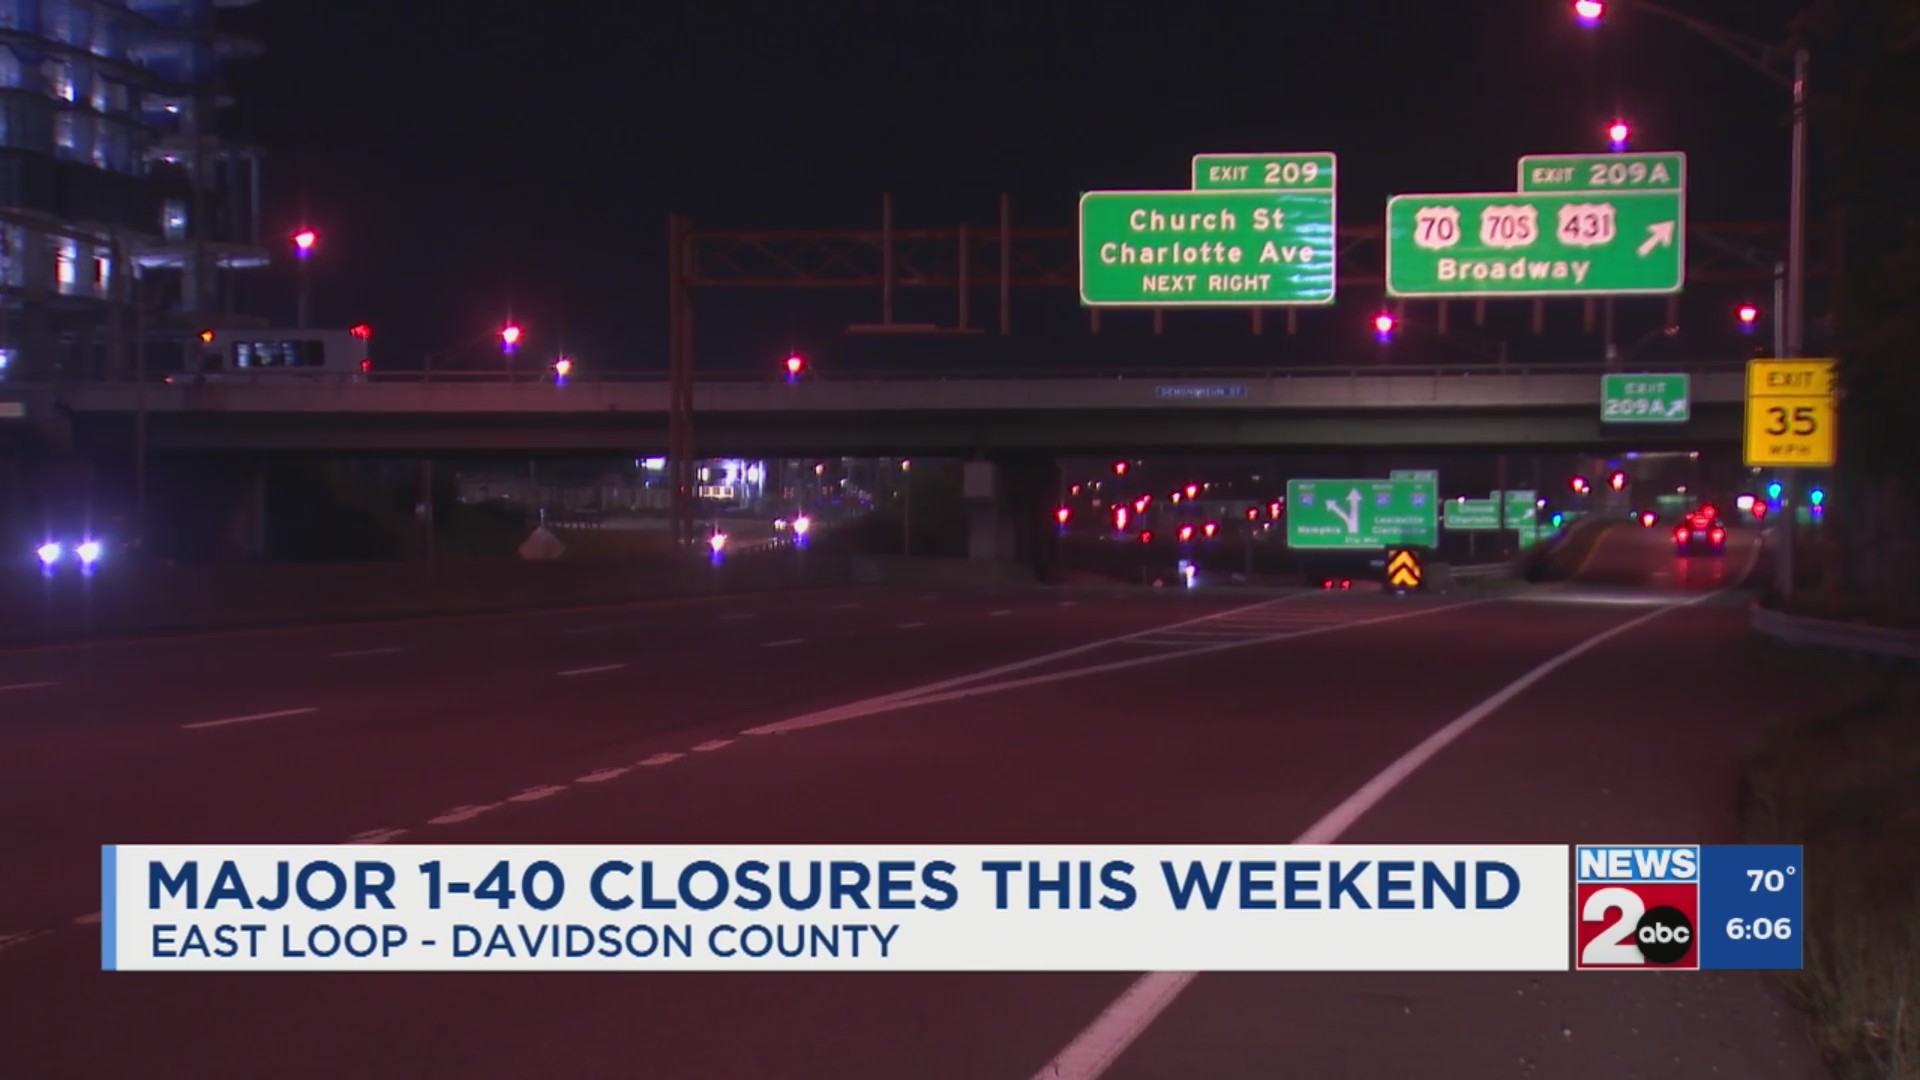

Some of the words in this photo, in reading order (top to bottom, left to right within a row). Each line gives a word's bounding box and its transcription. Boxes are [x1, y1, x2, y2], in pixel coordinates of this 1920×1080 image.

[1209, 165, 1249, 182] EXIT
[1264, 162, 1319, 184] 209
[1531, 166, 1575, 184] EXIT
[1588, 162, 1671, 185] 209A
[1129, 207, 1237, 231] Church
[1252, 207, 1285, 230] St
[1420, 216, 1454, 241] 70
[1487, 215, 1530, 240] 70S
[1562, 214, 1611, 239] 431
[1100, 241, 1243, 264] Charlotte
[1258, 240, 1315, 263] Ave
[1143, 274, 1197, 291] NEXT
[1208, 273, 1272, 291] RIGHT
[1437, 256, 1591, 284] Broadway
[1624, 382, 1668, 394] EXIT
[1766, 371, 1814, 388] EXIT
[1604, 399, 1666, 415] 209A
[1764, 405, 1818, 436] 35
